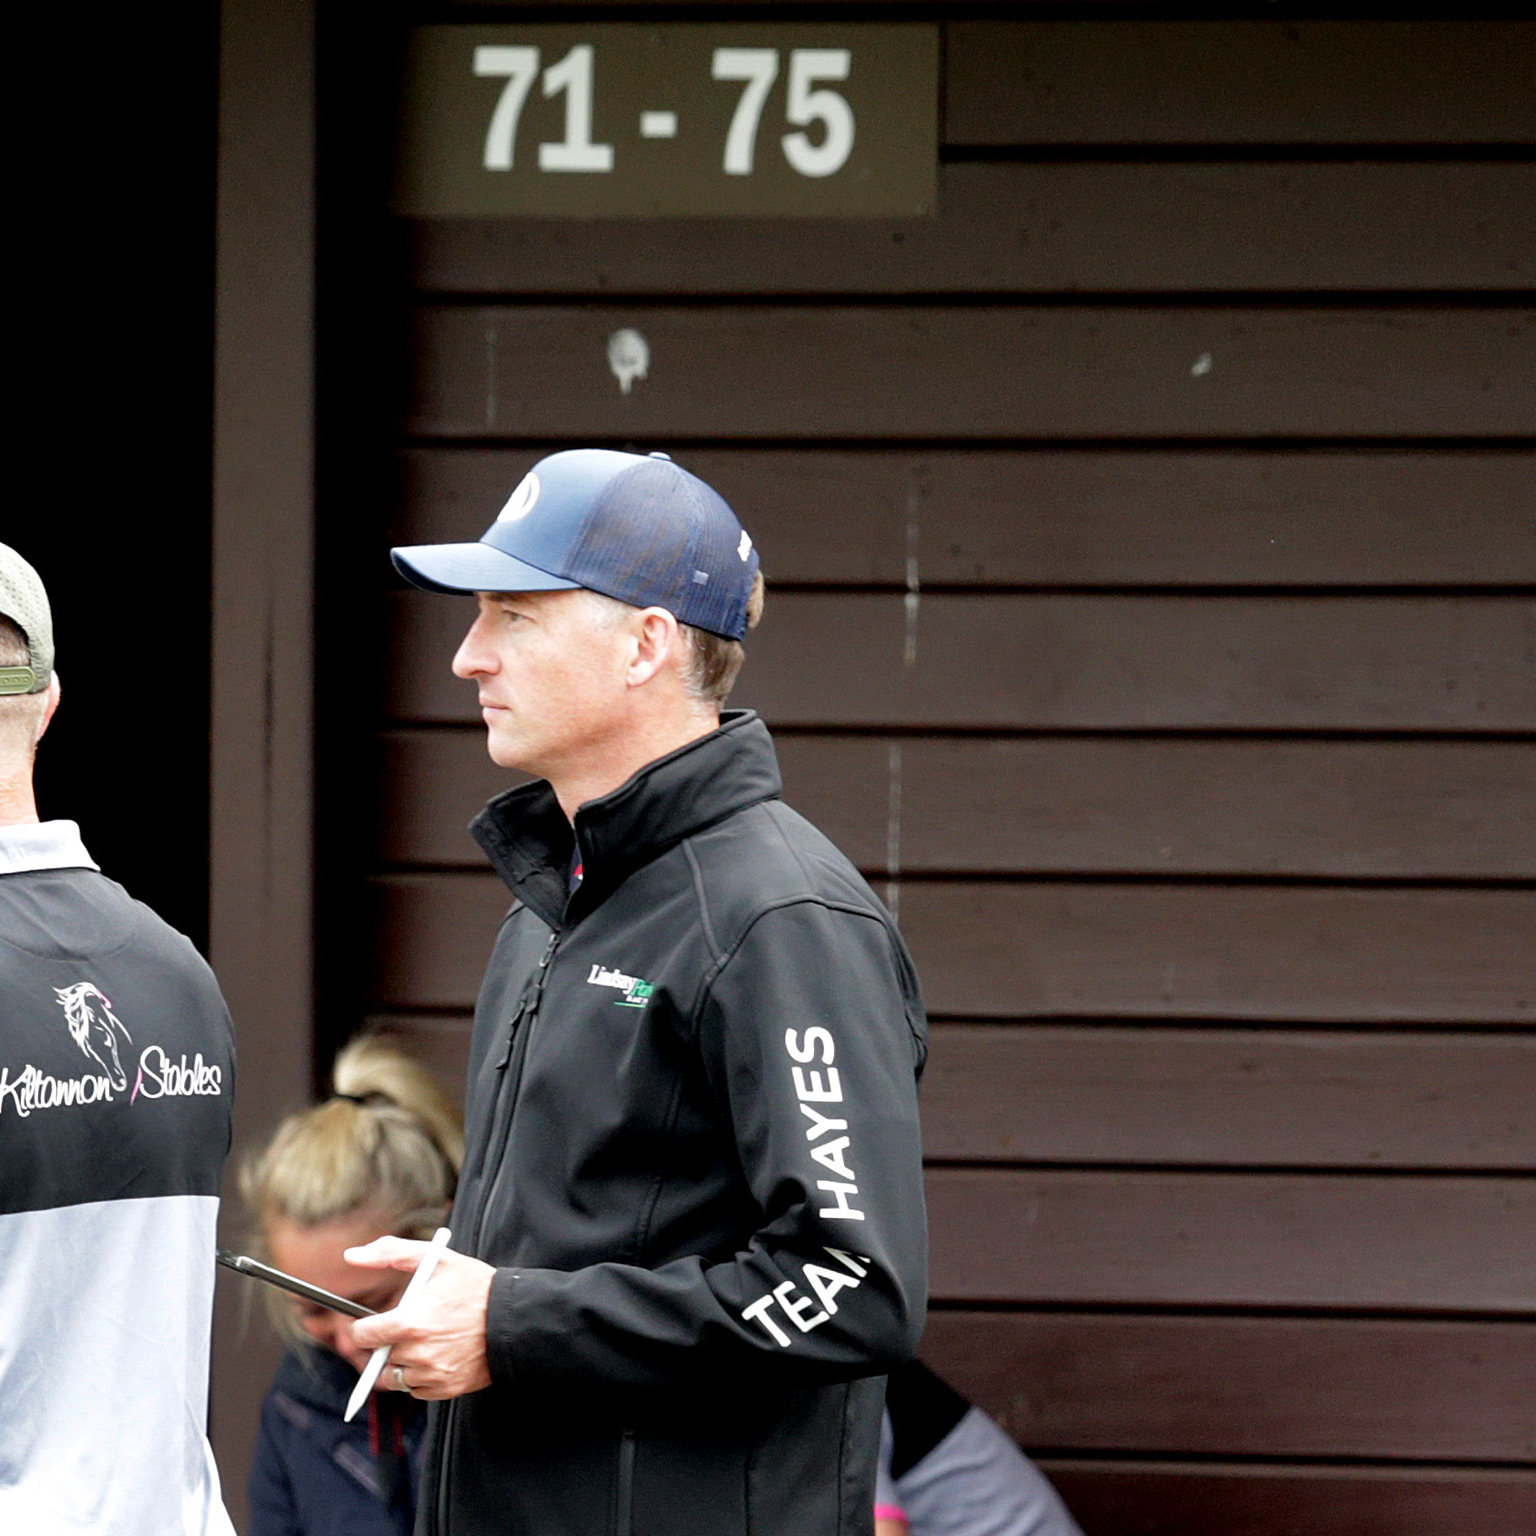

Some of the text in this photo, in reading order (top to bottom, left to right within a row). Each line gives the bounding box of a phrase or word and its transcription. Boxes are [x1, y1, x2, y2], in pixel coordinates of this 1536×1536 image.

[473, 44, 615, 174] 71
[711, 47, 856, 178] 75
[139, 1044, 222, 1099] Stables
[784, 1025, 865, 1221] HAYES
